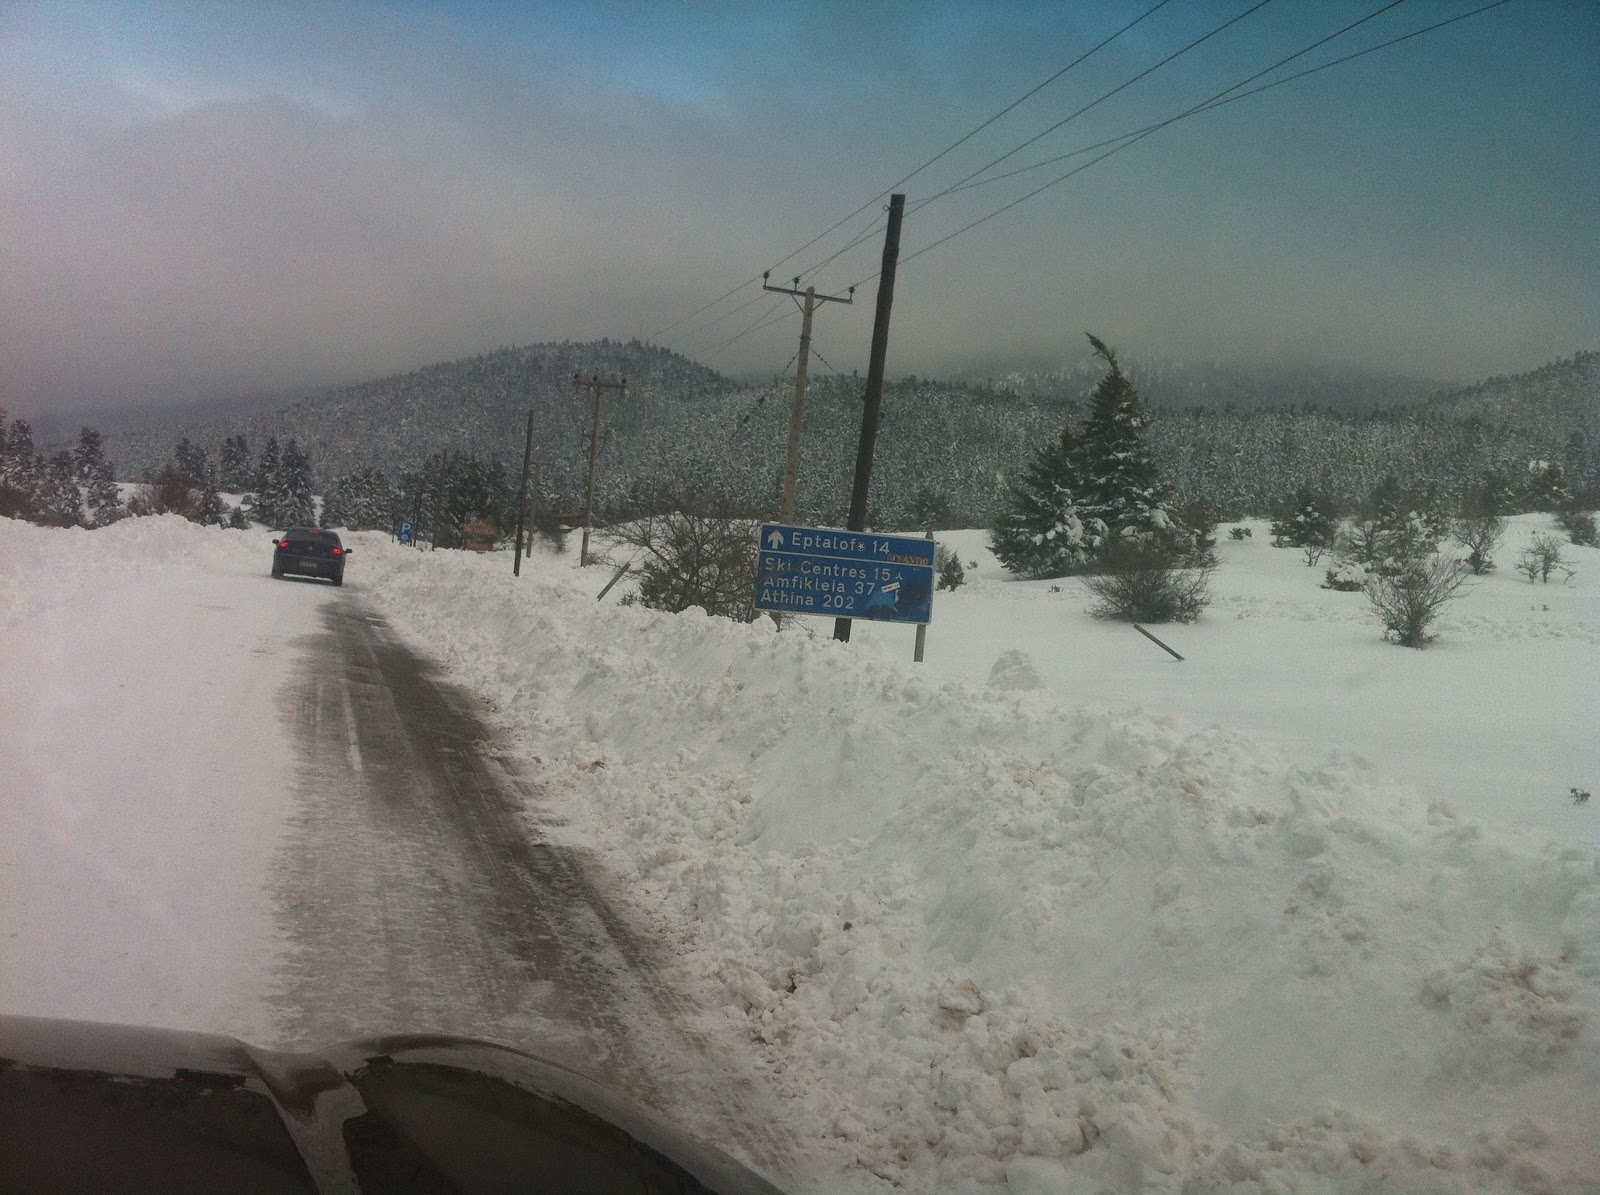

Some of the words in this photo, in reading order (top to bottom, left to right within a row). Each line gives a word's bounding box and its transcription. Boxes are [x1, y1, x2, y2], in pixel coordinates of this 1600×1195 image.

[401, 522, 411, 533] P
[791, 532, 866, 552] Eptalof
[872, 540, 890, 554] 14
[765, 558, 791, 572] Ski
[800, 561, 867, 579] Centres
[874, 568, 891, 581] 15
[763, 576, 845, 593] Amfikleia
[855, 582, 875, 595] 37
[760, 589, 814, 606] Athina
[823, 595, 855, 610] 202
